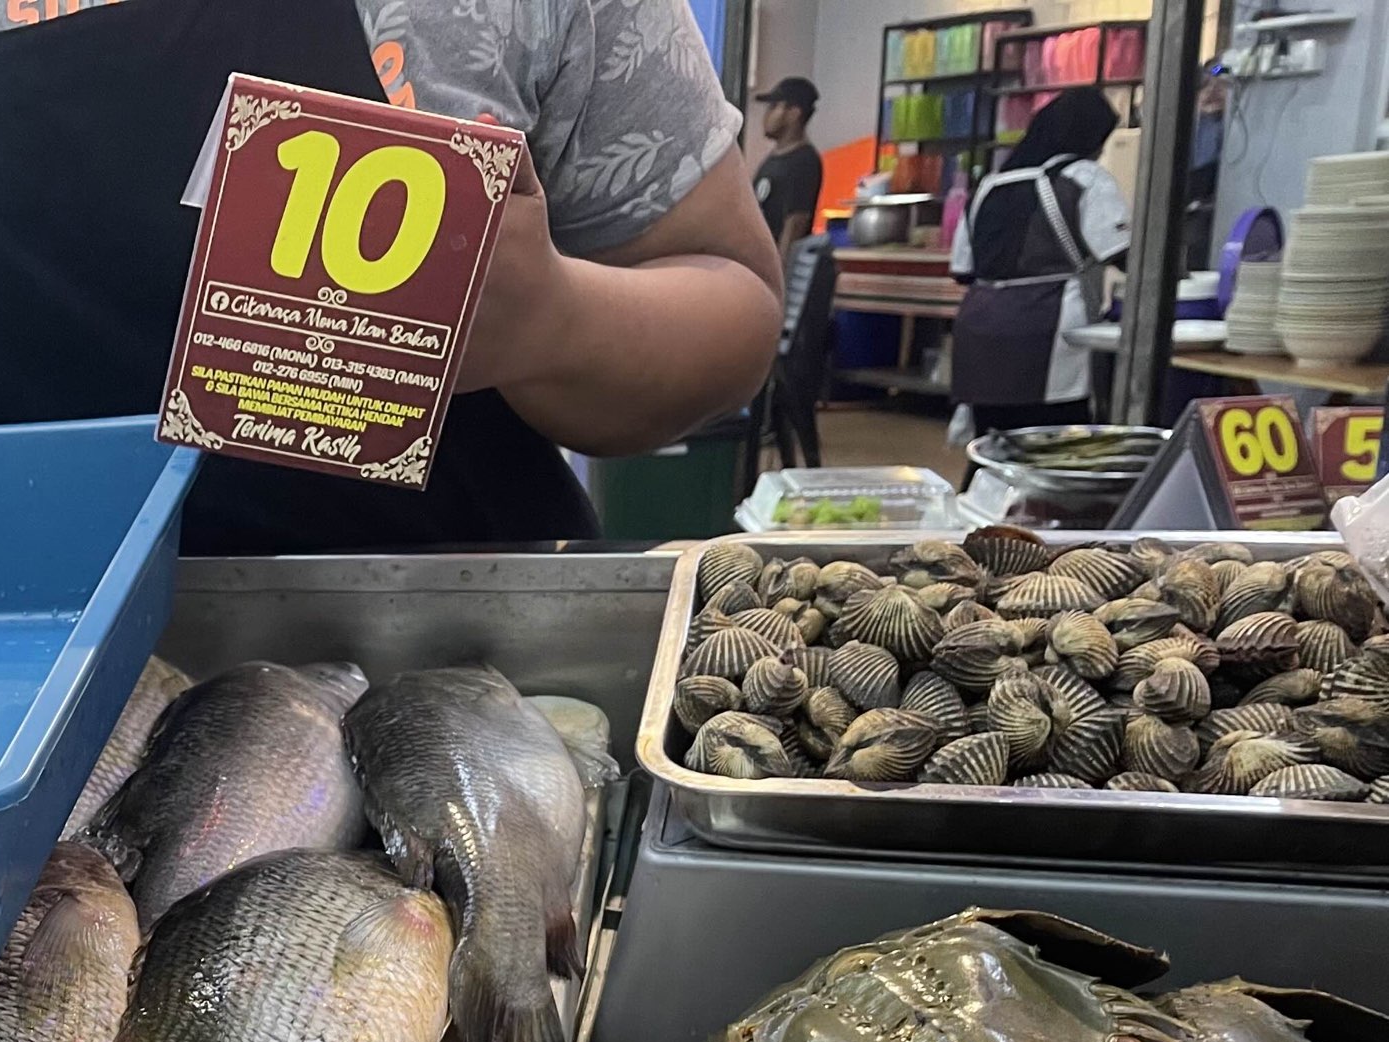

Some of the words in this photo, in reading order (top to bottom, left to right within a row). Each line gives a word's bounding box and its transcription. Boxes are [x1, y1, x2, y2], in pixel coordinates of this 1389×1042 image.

[270, 130, 447, 294] 10
[231, 295, 302, 325] Citarasa
[302, 307, 348, 332] Mona
[349, 316, 388, 340] Ikan
[389, 325, 441, 350] Bakar
[193, 332, 242, 351] 012-466
[270, 346, 318, 368] (MONA)
[322, 357, 367, 375] 013-315
[395, 370, 440, 391] (MAYA)
[252, 360, 298, 379] 012-276
[328, 375, 363, 393] (MIN)
[191, 365, 213, 379] SILA
[213, 369, 267, 389] PASTIKAN
[267, 379, 304, 396] PAPAN
[303, 386, 346, 404] MUDAH
[346, 395, 384, 411] UNTUK
[384, 402, 426, 419] DILIHAT
[214, 382, 237, 396] SILA
[238, 387, 271, 402] BAWA
[271, 393, 322, 412] BERSAMA
[322, 402, 360, 419] KETIKA
[360, 410, 405, 428] HENDAK
[238, 399, 294, 418] MEMBUAT
[293, 411, 367, 432] PEMBAYARAN
[231, 414, 296, 447] Terima
[301, 426, 361, 463] Kasih
[1221, 405, 1298, 476] 60
